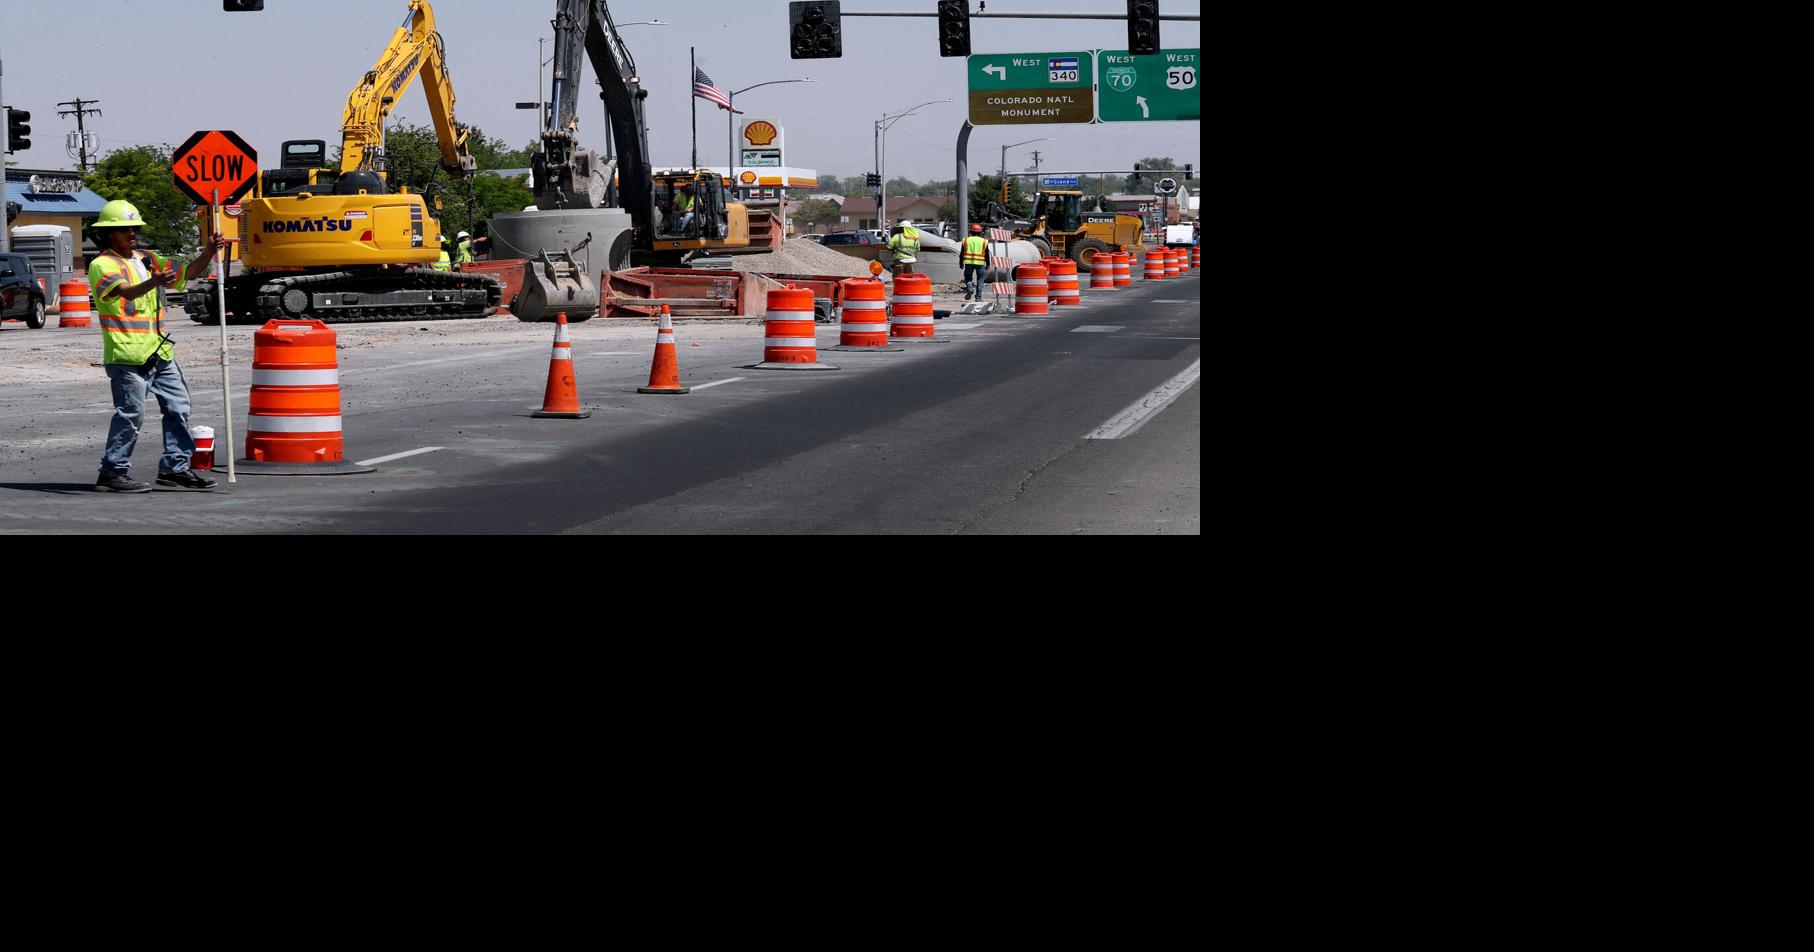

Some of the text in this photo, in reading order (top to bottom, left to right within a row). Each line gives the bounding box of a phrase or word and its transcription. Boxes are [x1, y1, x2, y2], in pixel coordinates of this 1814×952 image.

[603, 20, 624, 70] DEERE
[1012, 58, 1041, 67] WEST
[1106, 55, 1136, 63] WEST
[1166, 54, 1196, 62] WEST
[1051, 71, 1077, 80] 340
[1169, 71, 1193, 85] 50
[1111, 75, 1132, 87] 70
[987, 96, 1042, 105] COLORADO
[1001, 108, 1061, 117] MONUMENT
[186, 154, 243, 182] SLOW
[263, 216, 352, 233] KOMATSU
